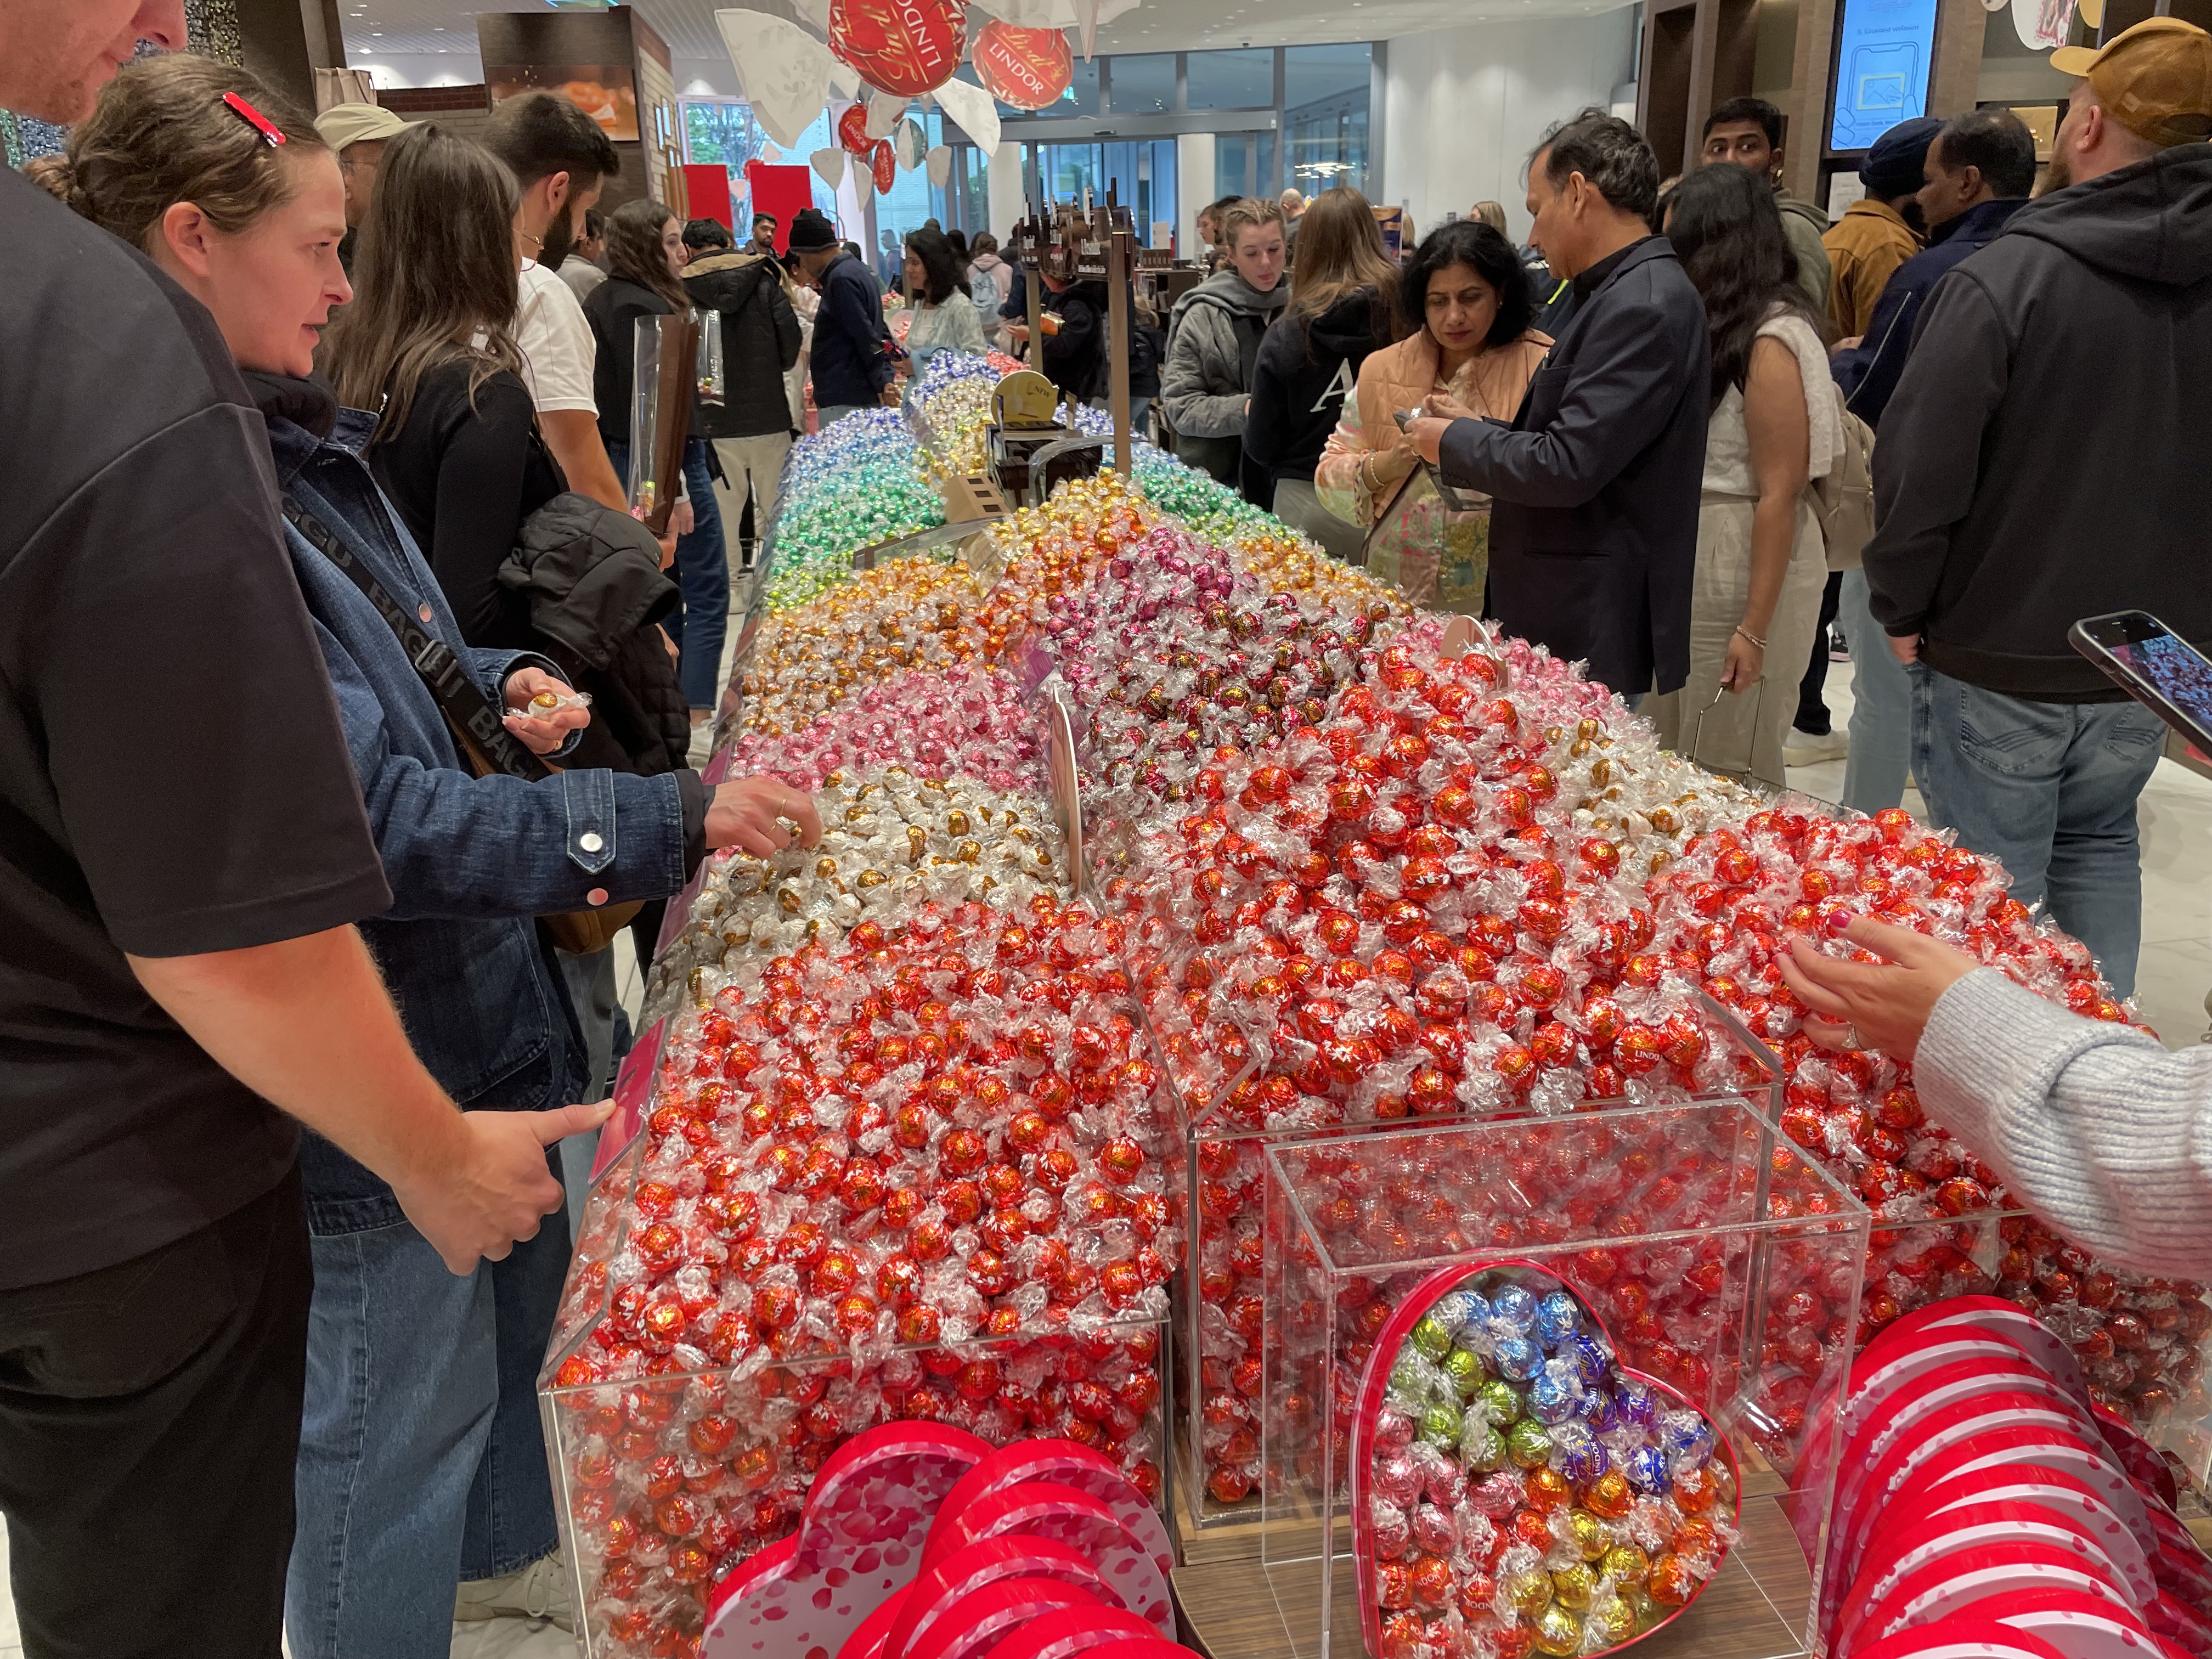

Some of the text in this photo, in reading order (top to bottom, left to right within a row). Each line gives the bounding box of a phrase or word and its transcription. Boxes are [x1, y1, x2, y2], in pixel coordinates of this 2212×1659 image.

[989, 43, 1045, 95] LINDOR
[468, 706, 531, 779] BAG
[1203, 874, 1214, 898] LINDO
